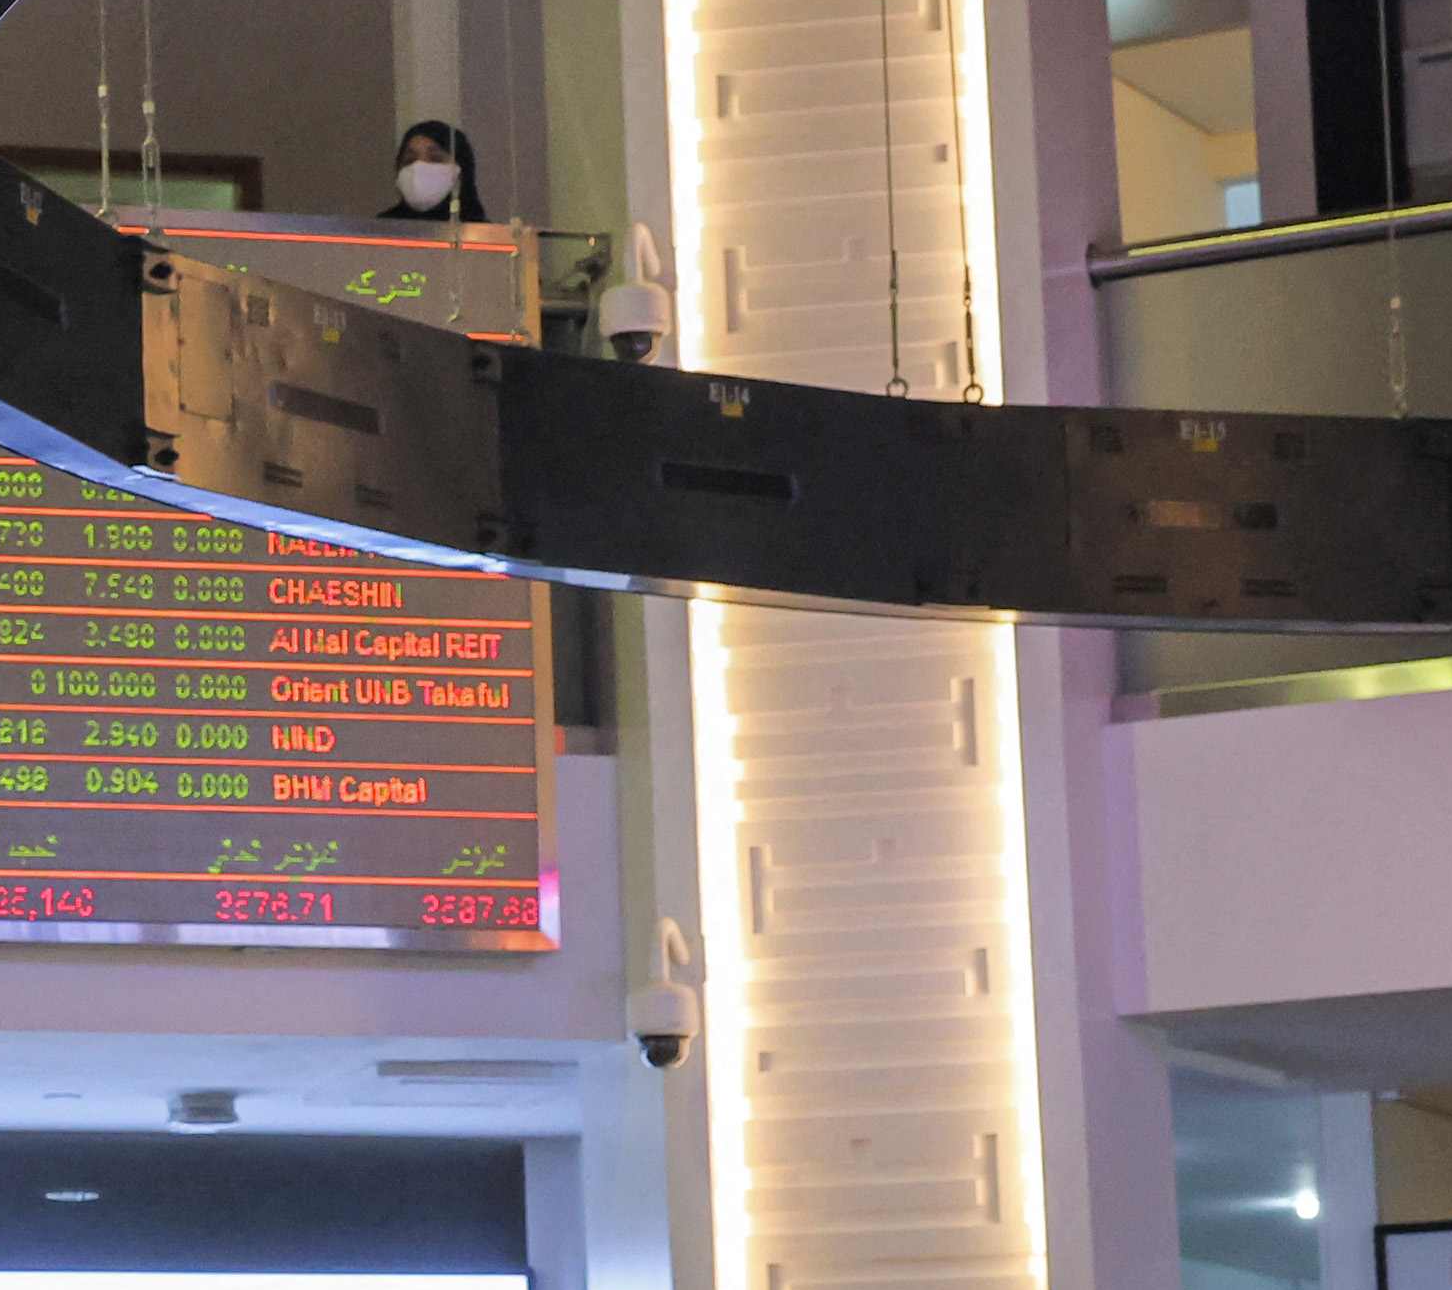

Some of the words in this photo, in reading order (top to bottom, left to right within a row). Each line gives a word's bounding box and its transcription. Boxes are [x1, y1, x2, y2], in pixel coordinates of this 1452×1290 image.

[267, 577, 405, 610] CHAESHIN
[445, 632, 503, 660] REIT
[270, 674, 350, 705] Orient
[416, 679, 511, 711] Takaful
